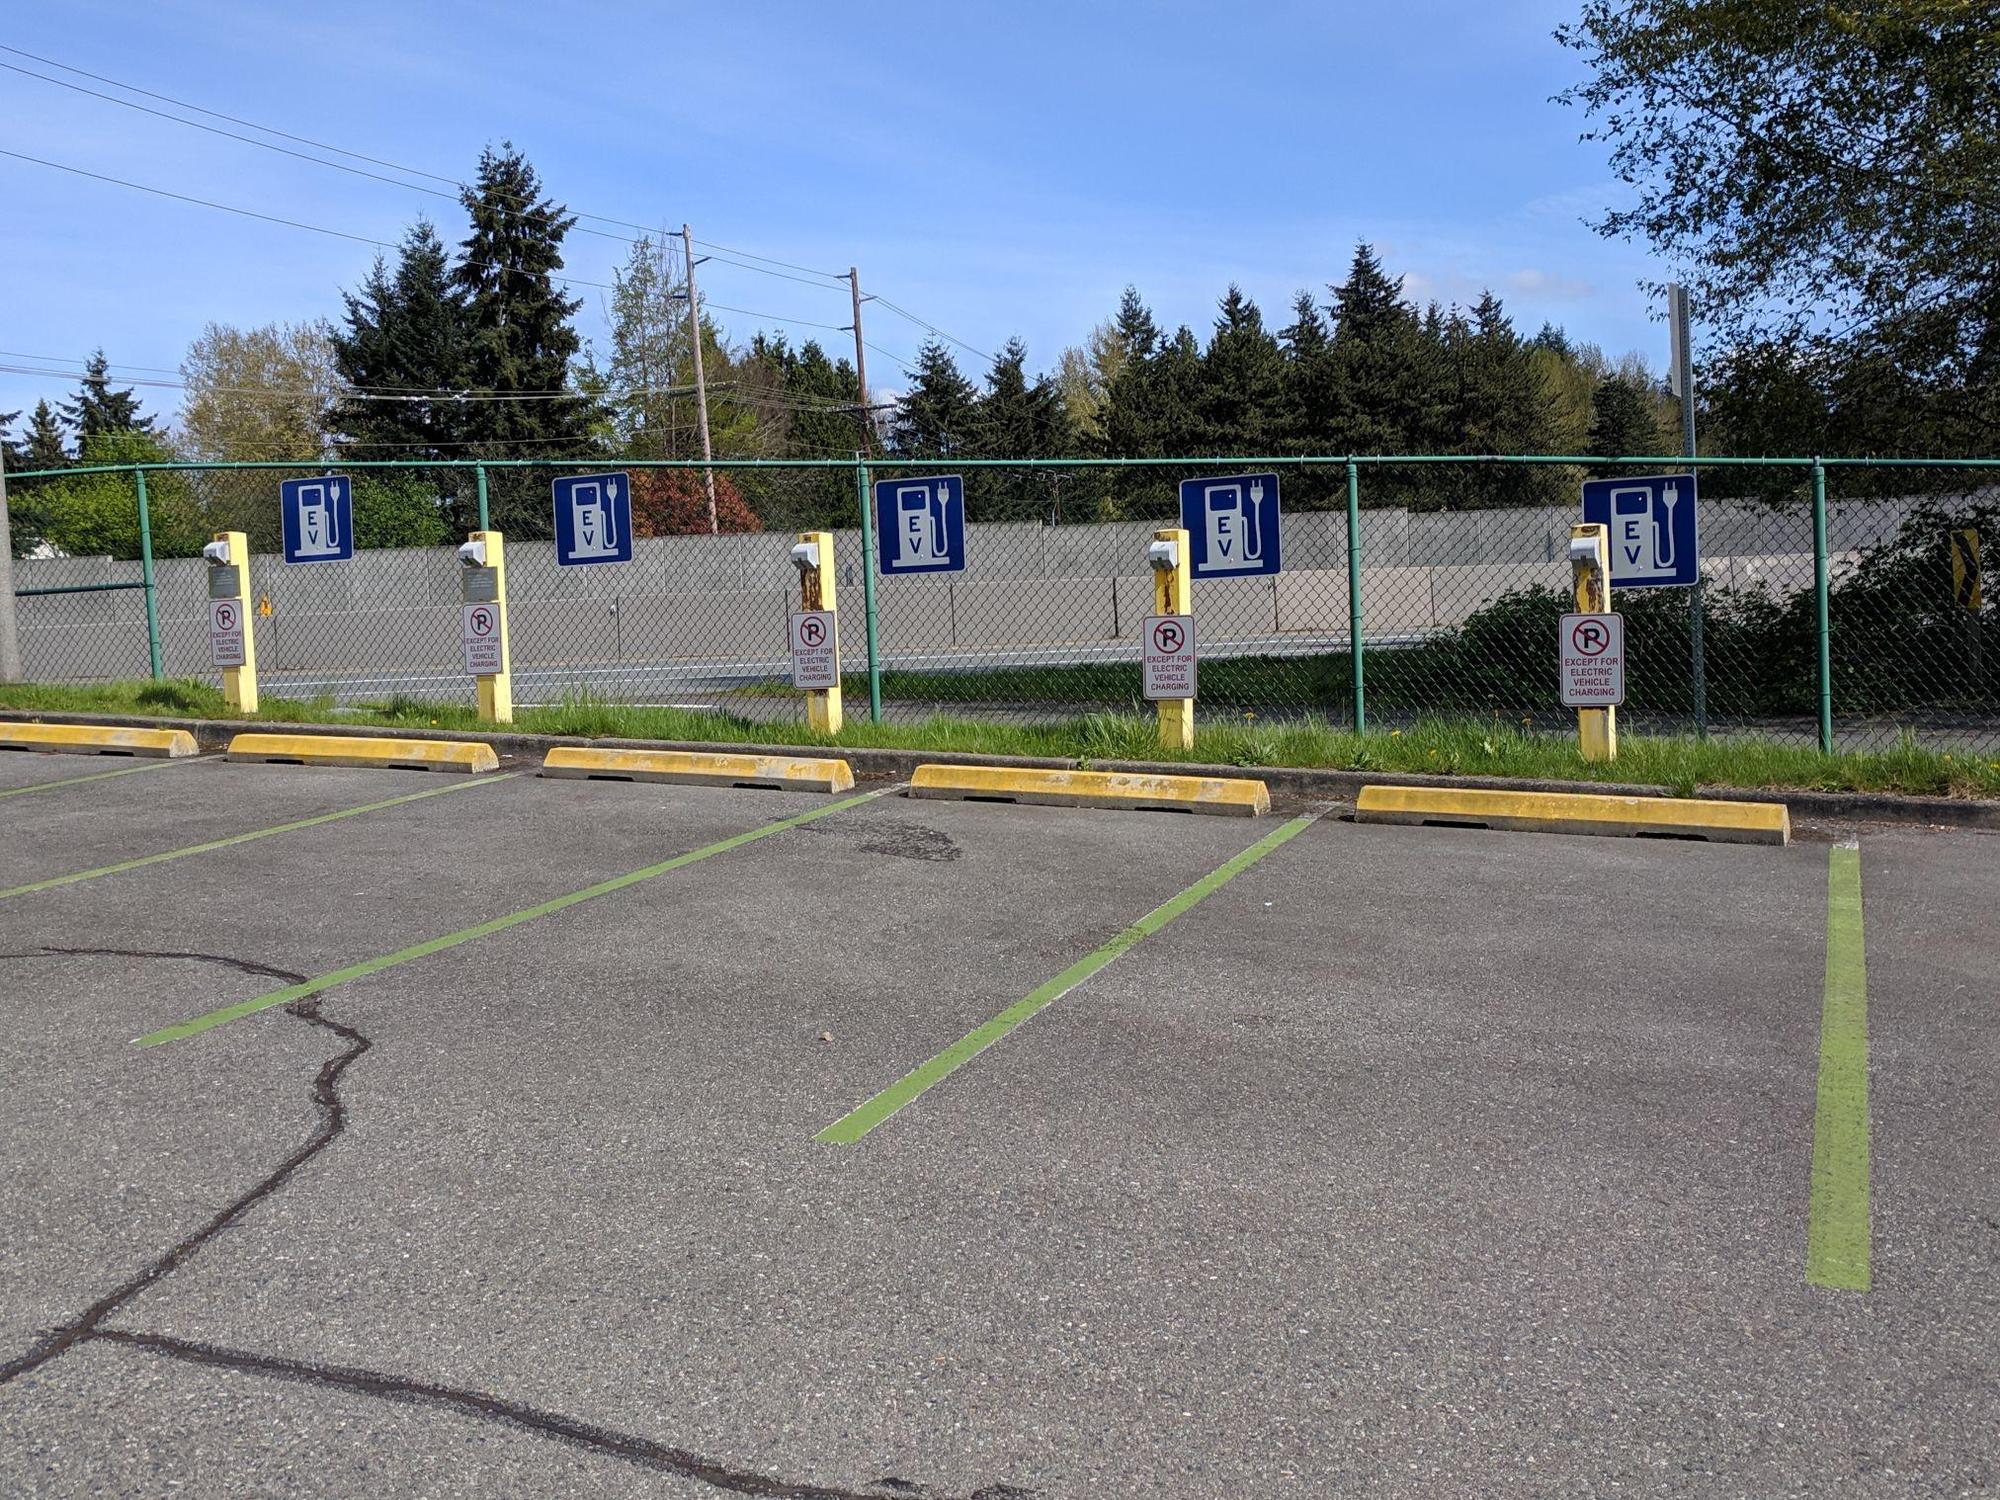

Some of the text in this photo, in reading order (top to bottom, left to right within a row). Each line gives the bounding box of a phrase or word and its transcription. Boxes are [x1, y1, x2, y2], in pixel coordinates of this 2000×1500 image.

[795, 648, 819, 656] EXCEPT
[1147, 655, 1176, 663] EXCEPT
[1565, 657, 1618, 666] EXCEPT FOR
[1152, 664, 1188, 672] ELECTRIC
[1570, 668, 1613, 676] ELECTRIC
[799, 673, 832, 681] CHARGING
[1154, 673, 1185, 681] VEHICLE
[1573, 678, 1610, 686] VEHICLE
[1151, 683, 1189, 691] CHARGING
[1569, 688, 1615, 696] CHARGING
